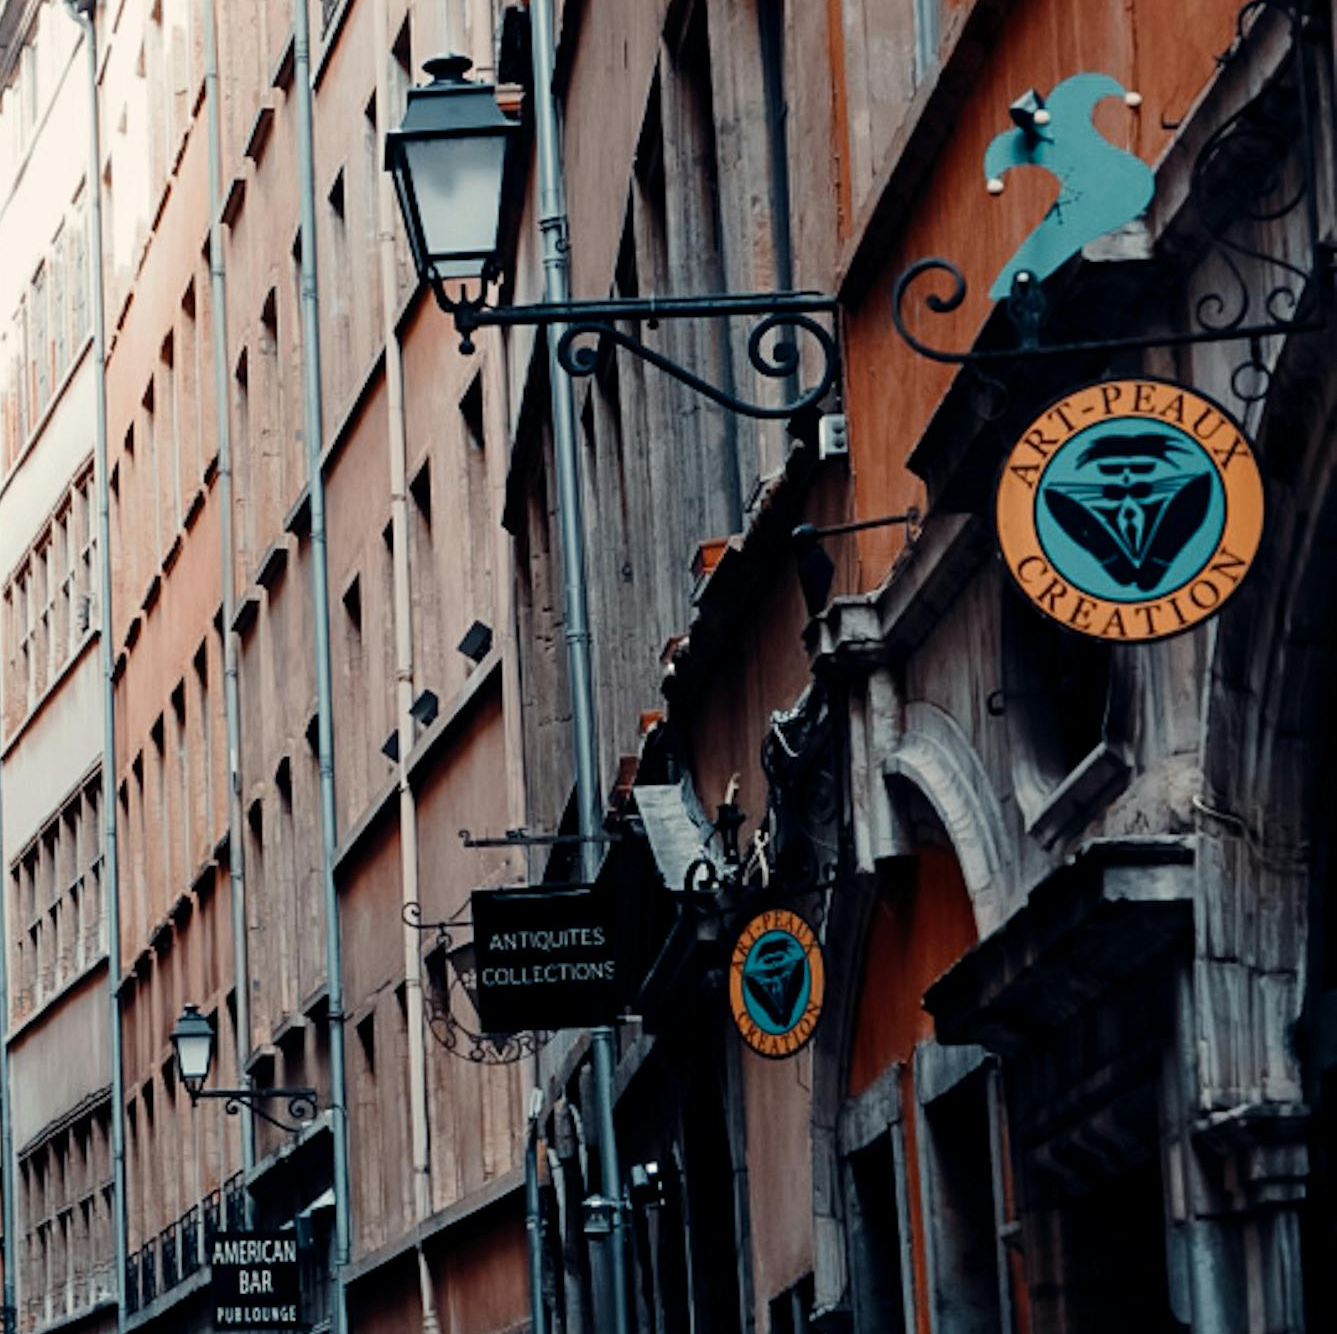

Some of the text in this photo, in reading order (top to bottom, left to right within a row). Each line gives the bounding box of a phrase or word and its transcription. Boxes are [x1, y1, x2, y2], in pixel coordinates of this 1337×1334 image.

[1010, 383, 1251, 489] ART-PEAUX
[1016, 545, 1247, 637] CREATION
[488, 927, 606, 953] ANTIQUITES
[481, 960, 616, 987] COLLECTIONS
[213, 1240, 297, 1265] AMERICAN
[239, 1269, 273, 1295] BAR
[217, 1305, 297, 1323] PUB LOUNGE
